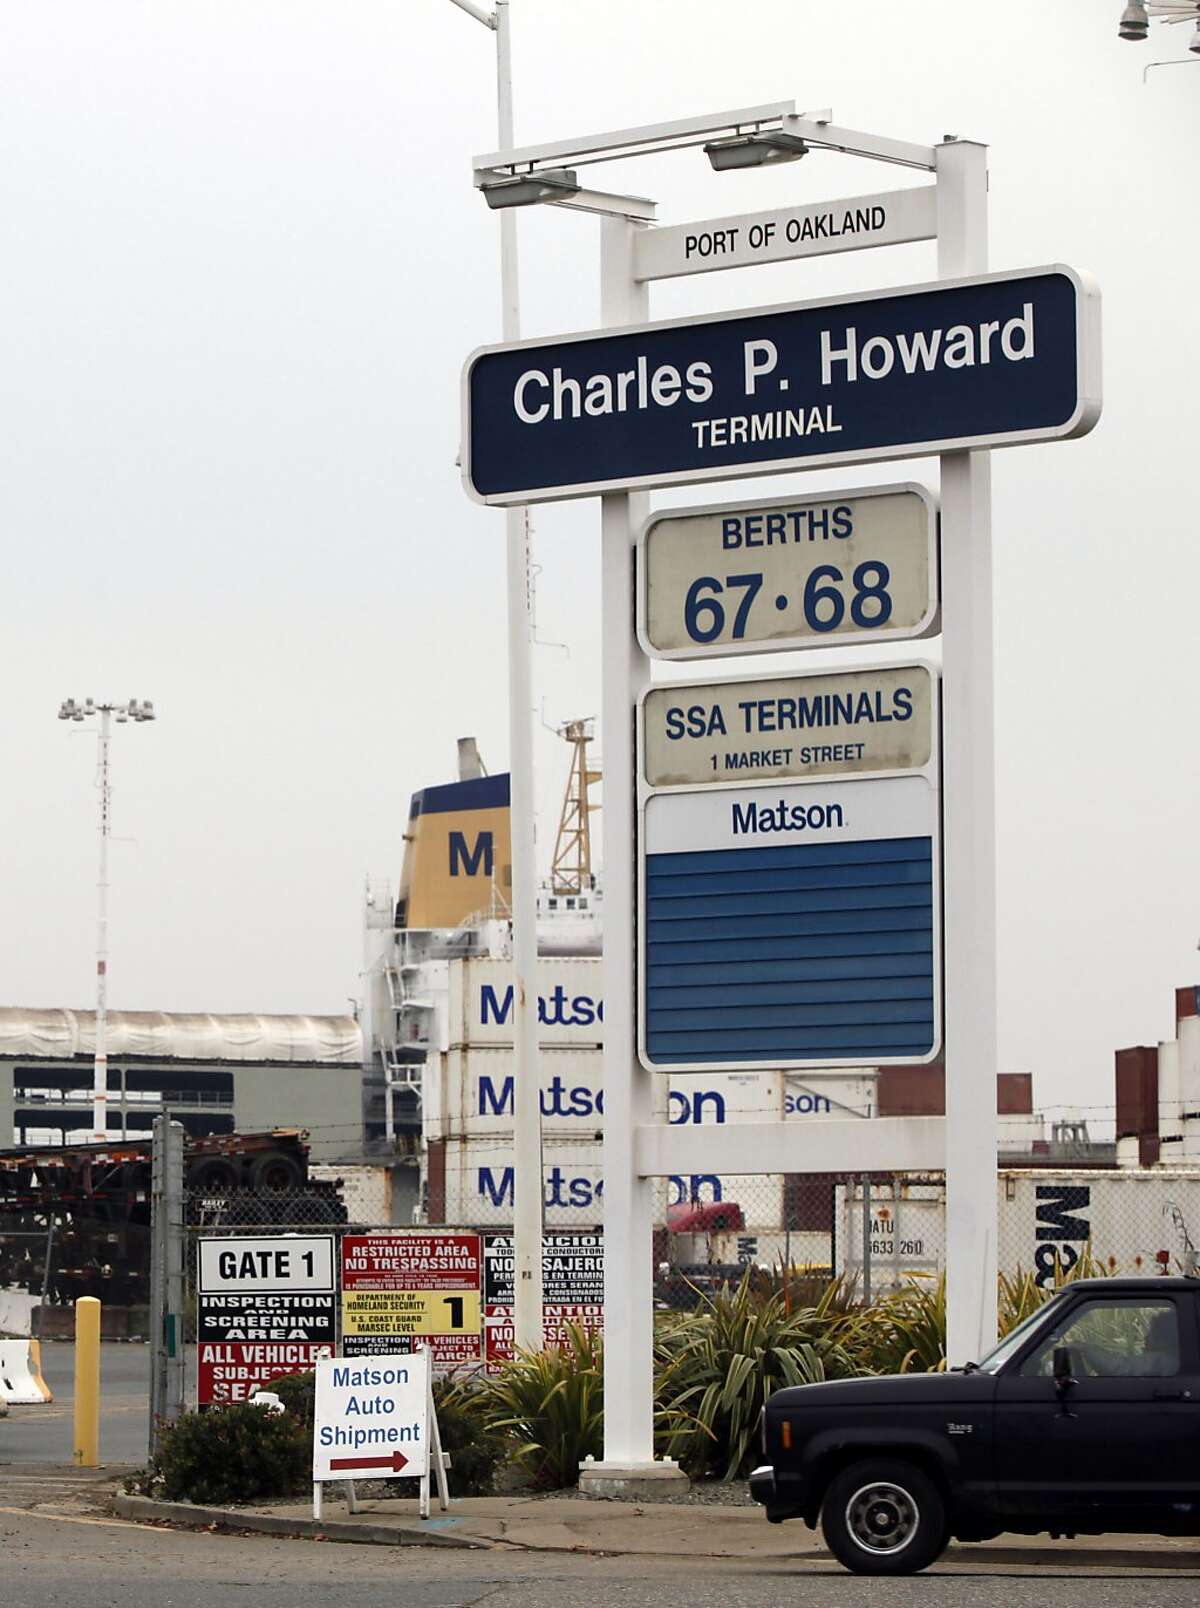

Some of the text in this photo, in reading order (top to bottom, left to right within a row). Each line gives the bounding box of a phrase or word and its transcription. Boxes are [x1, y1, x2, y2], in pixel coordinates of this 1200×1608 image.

[685, 206, 886, 259] PORT OF OAKLAND
[513, 303, 1035, 425] Charles P. Howard
[692, 405, 843, 449] TERMINAL
[722, 505, 853, 550] BERTHS
[665, 688, 913, 741] SSA TERMINALS
[711, 743, 865, 770] 1 MARKET STREET
[731, 800, 844, 835] Matson
[448, 831, 494, 877] M
[492, 1237, 604, 1247] ATNCIO
[352, 1246, 469, 1258] RESTRICTED AREA
[546, 1248, 604, 1256] CONDUCTOR
[218, 1251, 314, 1280] GATE 1
[345, 1257, 477, 1270] NO TRESPASSING
[542, 1258, 604, 1272] SAJERO
[567, 1272, 604, 1280] TERMIN
[201, 1296, 333, 1308] INSPECTION
[356, 1294, 416, 1302] DEPARTMENT OF
[347, 1301, 426, 1311] HOMELAND SECURITY
[492, 1305, 604, 1317] ATNTIO
[443, 1296, 464, 1329] 1
[204, 1316, 329, 1328] SCREENING
[368, 1315, 394, 1323] COAST
[395, 1315, 422, 1323] GUARD
[357, 1323, 416, 1333] MARSEC LEVEL
[224, 1329, 309, 1340] AREA
[344, 1336, 410, 1344] INSPECTION
[433, 1336, 479, 1345] VEHICLES
[201, 1345, 236, 1364] ALL
[346, 1347, 409, 1355] SCREENING
[434, 1351, 477, 1361] ARCH
[333, 1367, 409, 1388] Matson
[345, 1396, 396, 1416] Auto
[320, 1423, 420, 1450] Shipment
